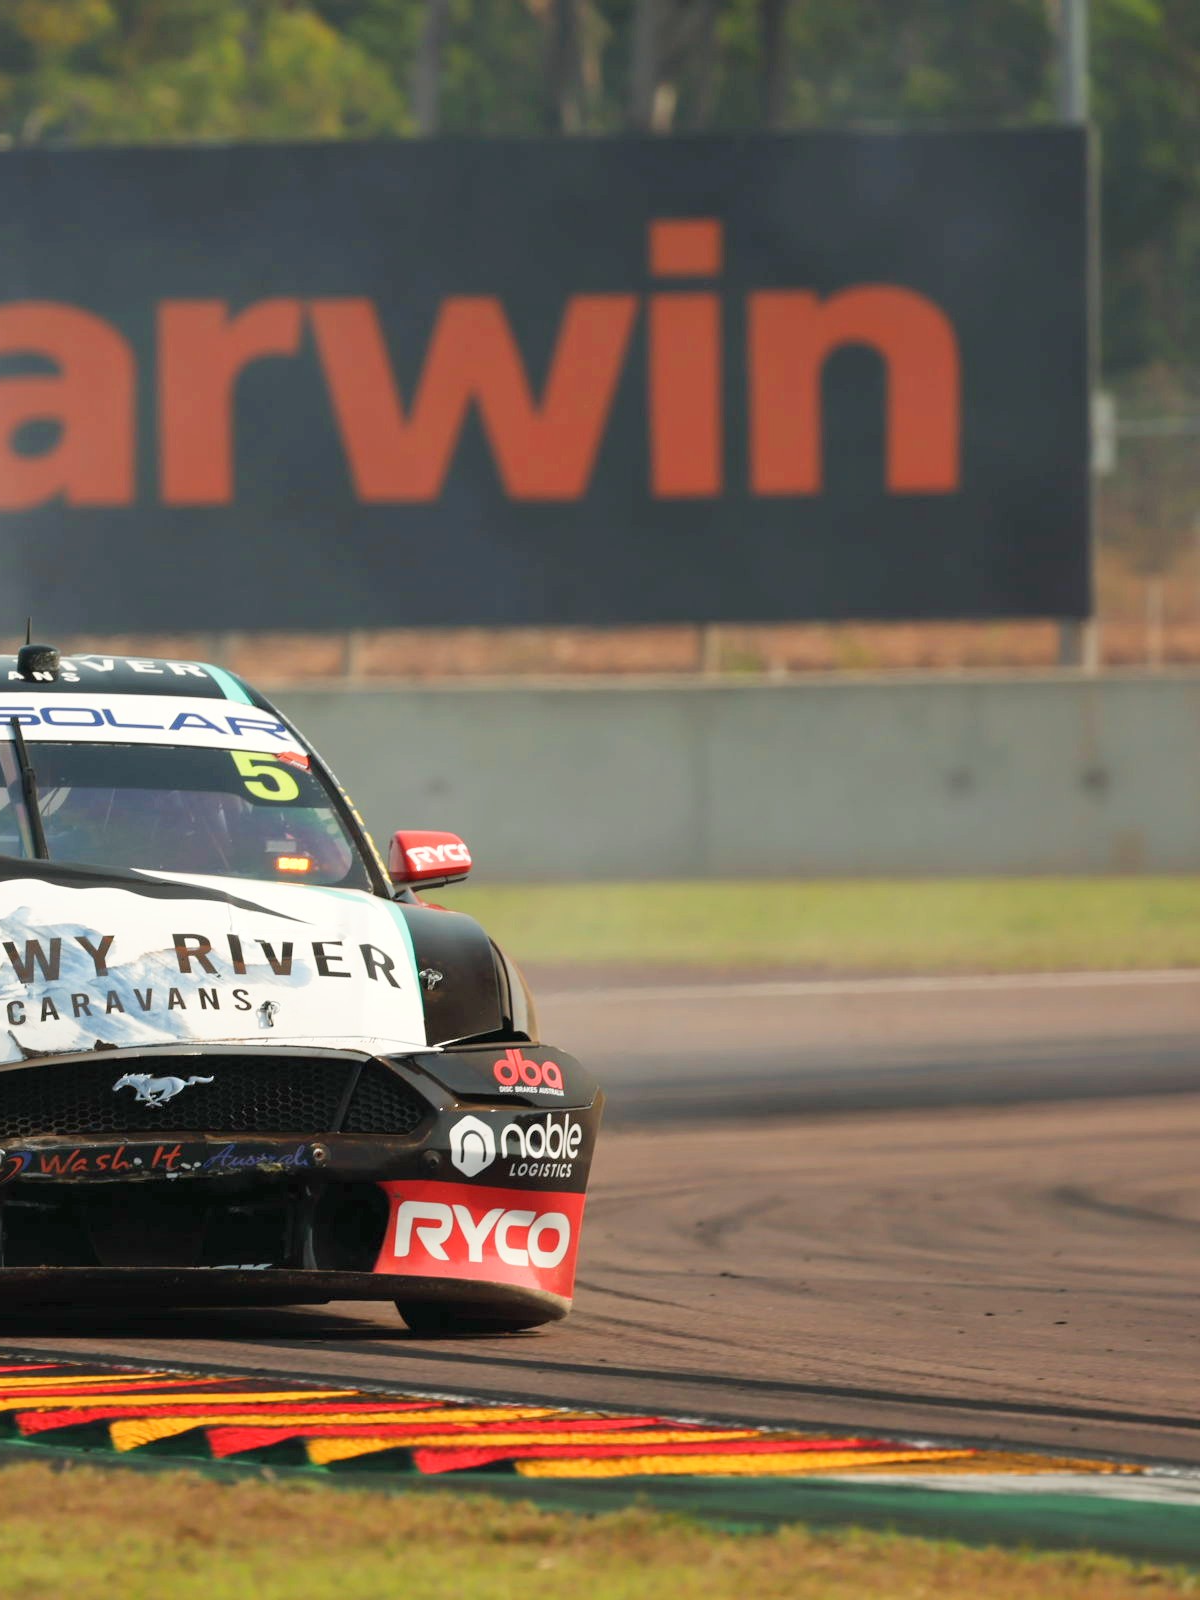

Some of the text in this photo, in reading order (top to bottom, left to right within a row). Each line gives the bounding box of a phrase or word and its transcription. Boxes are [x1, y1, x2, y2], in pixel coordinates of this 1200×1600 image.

[13, 658, 209, 678] IVER
[230, 750, 300, 802] 5
[173, 933, 402, 989] RIVER
[7, 986, 254, 1026] CARAVANS
[494, 1048, 564, 1089] dba
[39, 1146, 131, 1175] Wash
[151, 1145, 183, 1171] It
[501, 1113, 583, 1166] noble
[509, 1162, 573, 1179] LOGISTICS
[394, 1200, 571, 1269] RYCO
